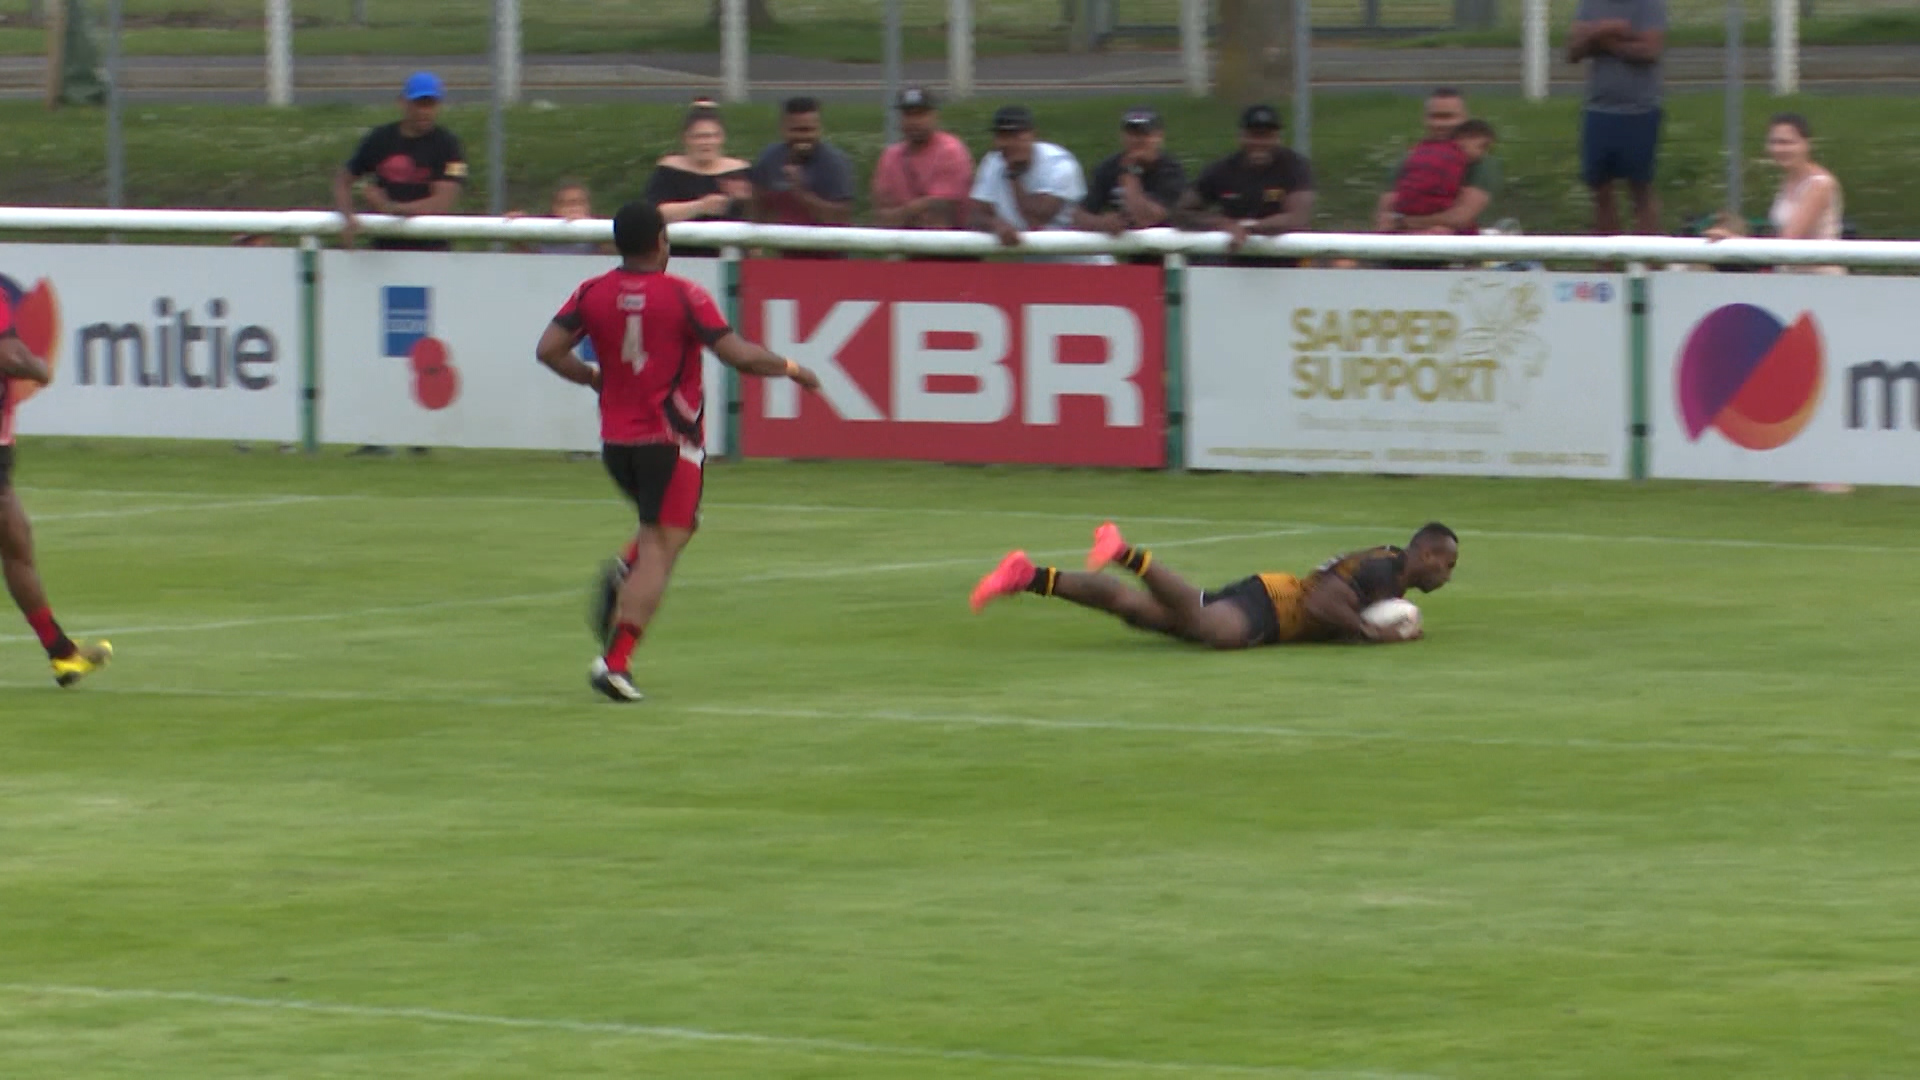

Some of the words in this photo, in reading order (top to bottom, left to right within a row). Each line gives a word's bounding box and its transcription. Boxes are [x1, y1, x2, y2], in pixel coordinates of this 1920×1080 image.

[78, 297, 279, 391] mitie
[620, 315, 648, 375] 4
[1290, 307, 1459, 353] SAPPER
[762, 299, 1144, 427] KBR
[1291, 357, 1499, 402] SUPPORT
